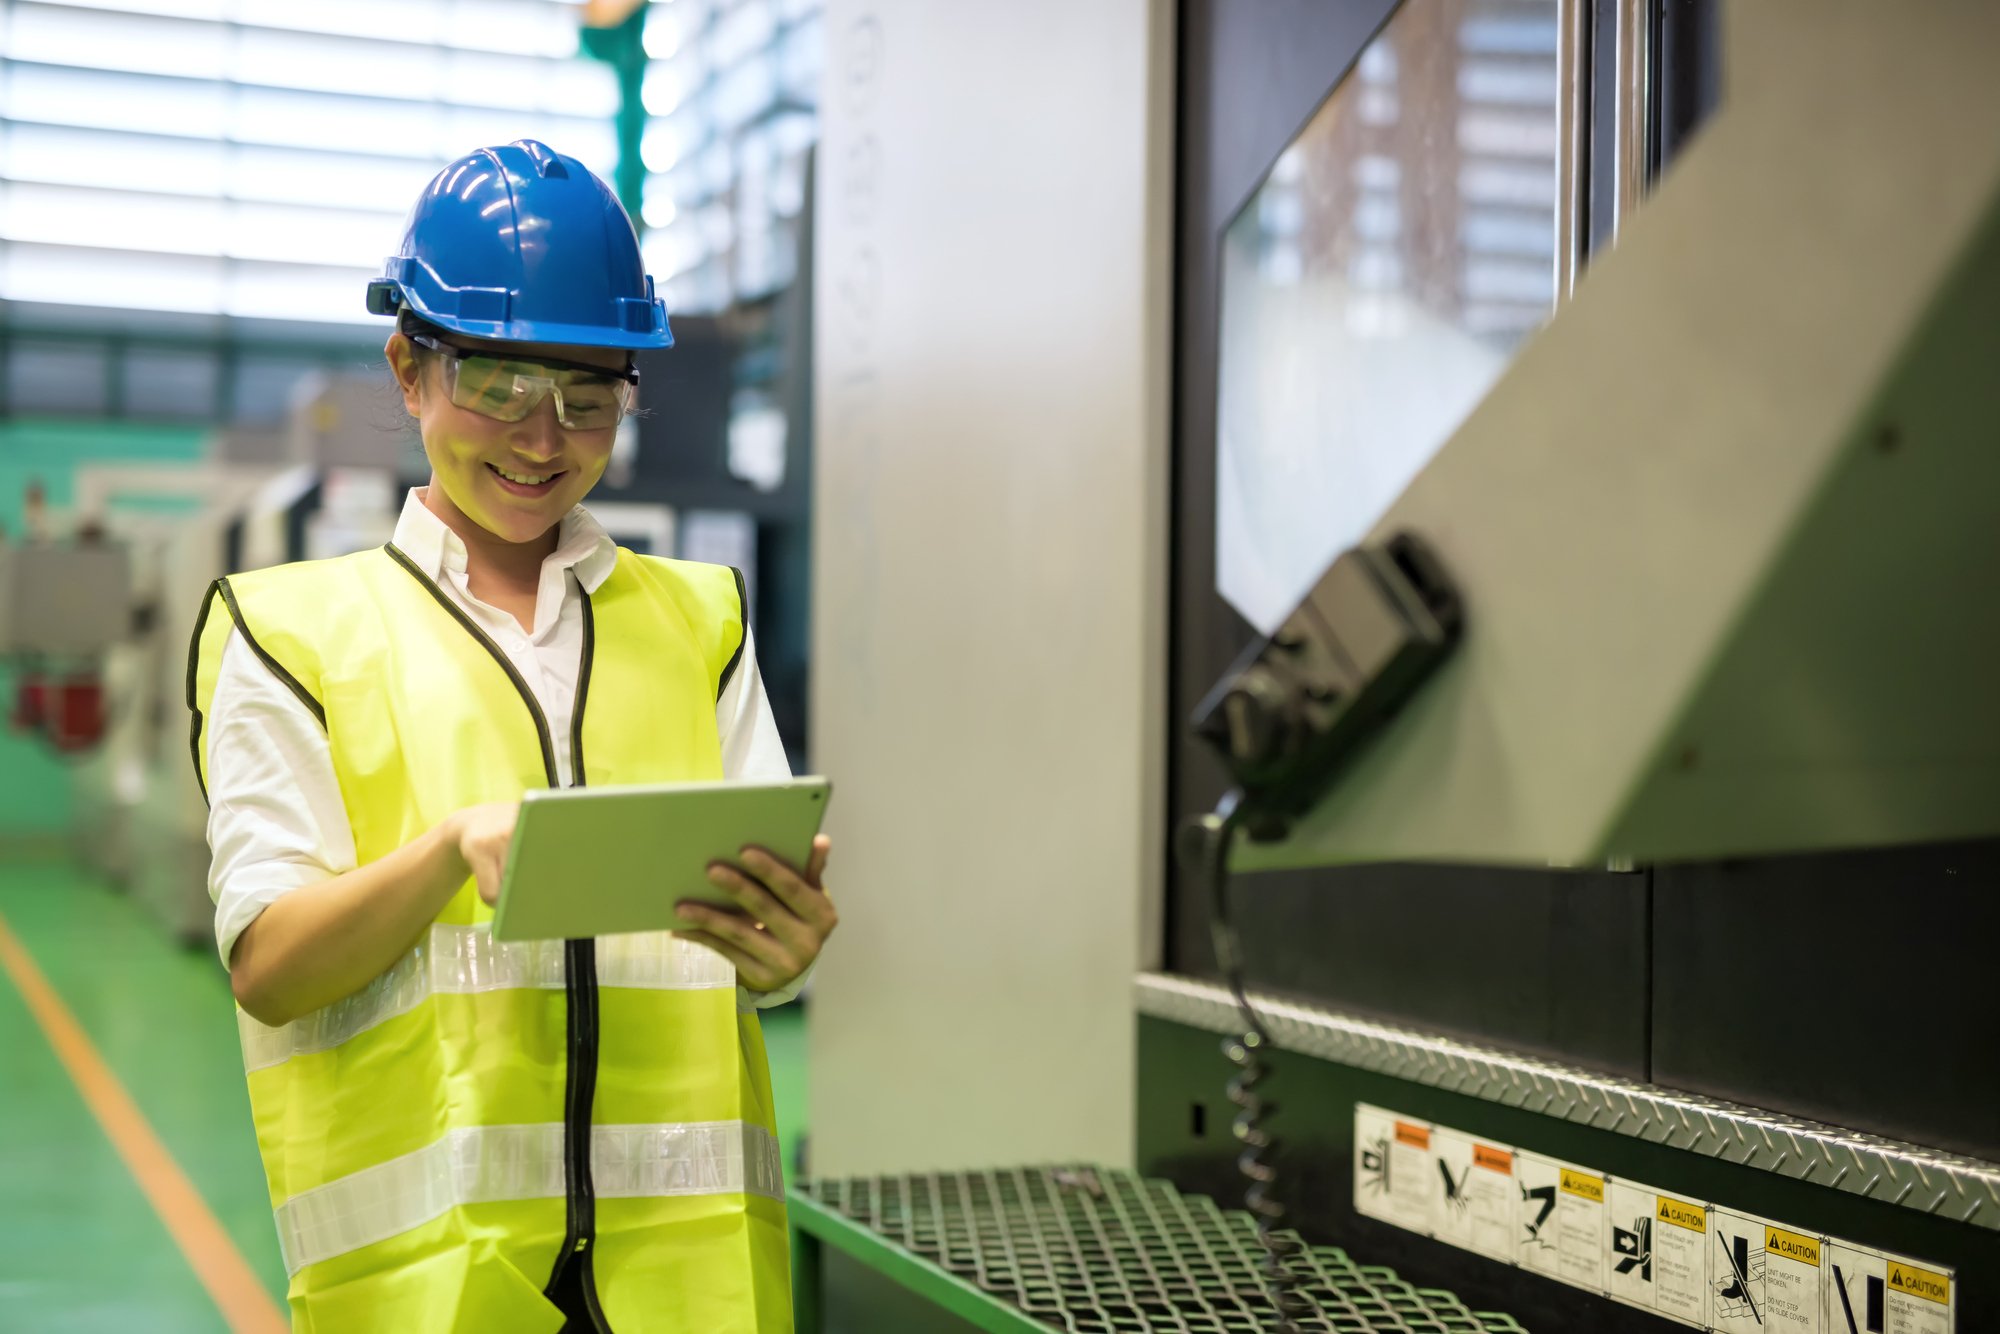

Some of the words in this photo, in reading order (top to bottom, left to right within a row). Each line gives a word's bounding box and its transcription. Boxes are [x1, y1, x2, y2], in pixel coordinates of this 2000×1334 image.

[1671, 1209, 1703, 1227] CAUTION
[1781, 1240, 1817, 1260] CAUTION
[1767, 1267, 1779, 1277] UNIT
[1779, 1271, 1794, 1281] MIGHT
[1794, 1275, 1801, 1284] BE
[1905, 1276, 1946, 1298] CAUTION
[1767, 1296, 1775, 1304] DO
[1775, 1299, 1785, 1308] NOT
[1786, 1302, 1798, 1312] STEP
[1889, 1295, 1896, 1304] Do
[1767, 1305, 1775, 1313] ON
[1775, 1307, 1788, 1319] SLIDE
